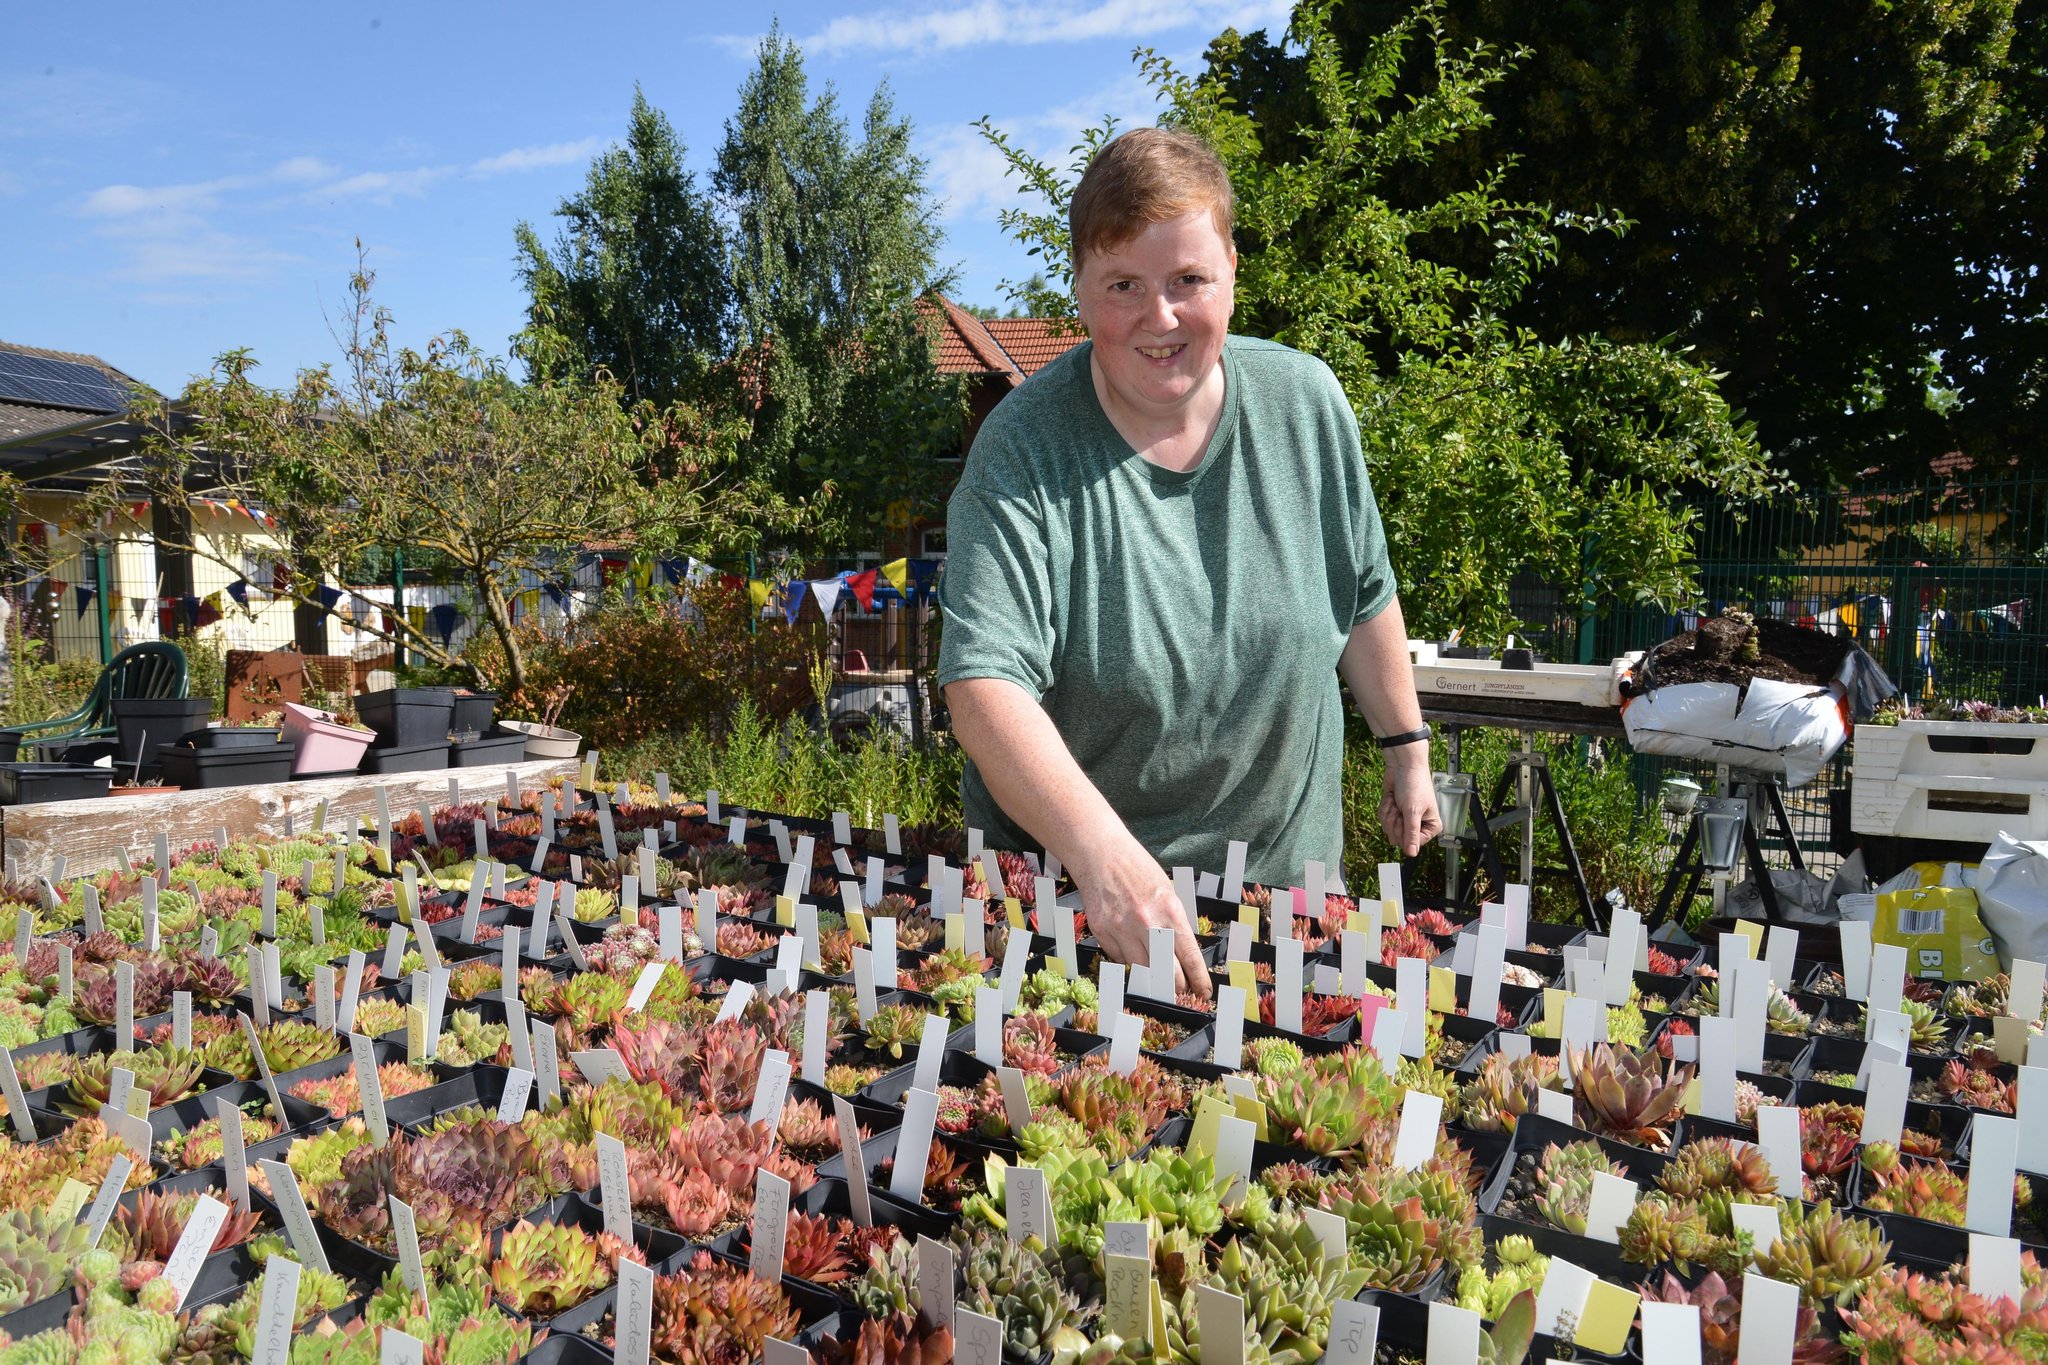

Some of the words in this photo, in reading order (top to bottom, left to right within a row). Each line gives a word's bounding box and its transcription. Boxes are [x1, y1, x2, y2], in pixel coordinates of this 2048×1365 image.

[1435, 676, 1476, 692] Gernert
[627, 1277, 642, 1365] Kaleidos
[1128, 1269, 1145, 1333] Queen
